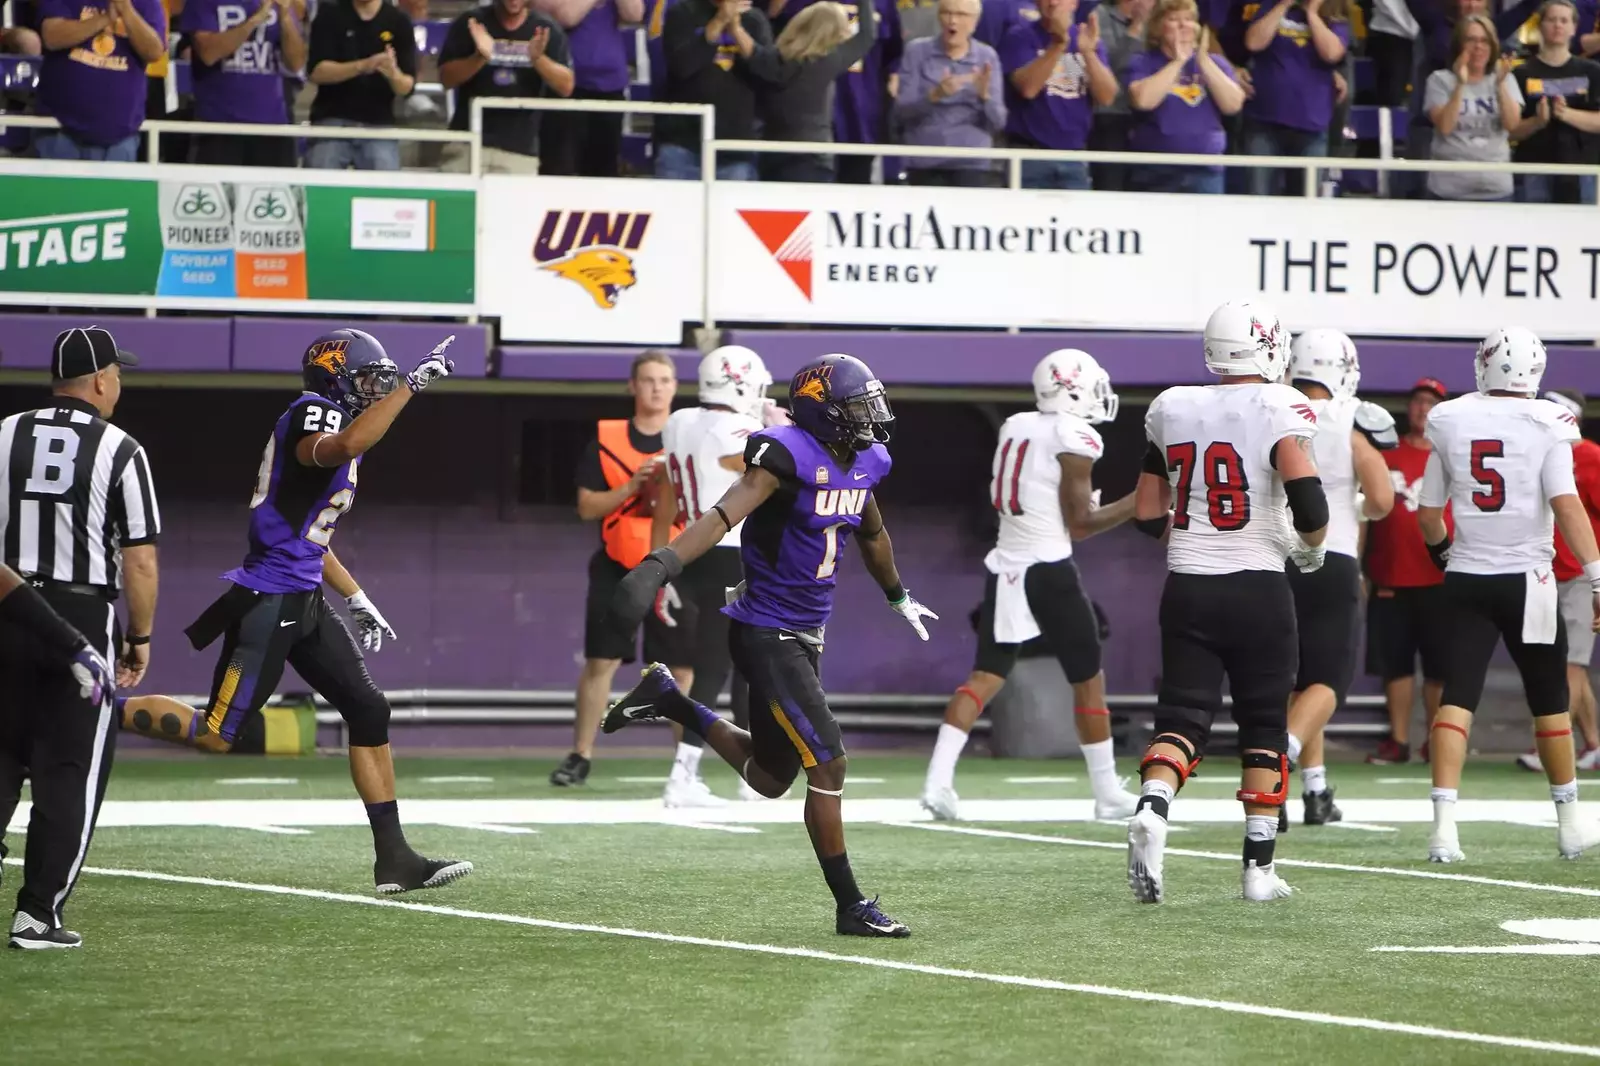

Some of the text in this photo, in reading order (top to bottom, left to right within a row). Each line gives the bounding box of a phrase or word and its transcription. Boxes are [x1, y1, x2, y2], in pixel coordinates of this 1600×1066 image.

[0, 221, 128, 271] TAGE
[167, 226, 230, 244] PIONEER
[239, 230, 301, 249] PIONEER
[533, 209, 652, 262] UNI
[824, 206, 1143, 255] MidAmerican
[828, 263, 938, 283] ENERGY
[1249, 239, 1349, 293] THE
[1373, 241, 1561, 300] POWER
[303, 405, 342, 434] 29
[25, 424, 81, 495] B
[751, 442, 771, 466] 1
[993, 437, 1030, 516] 11
[1470, 439, 1506, 512] 5
[815, 489, 870, 516] UNI
[1165, 440, 1251, 531] 78
[304, 488, 356, 546] 2
[815, 521, 849, 579] 1
